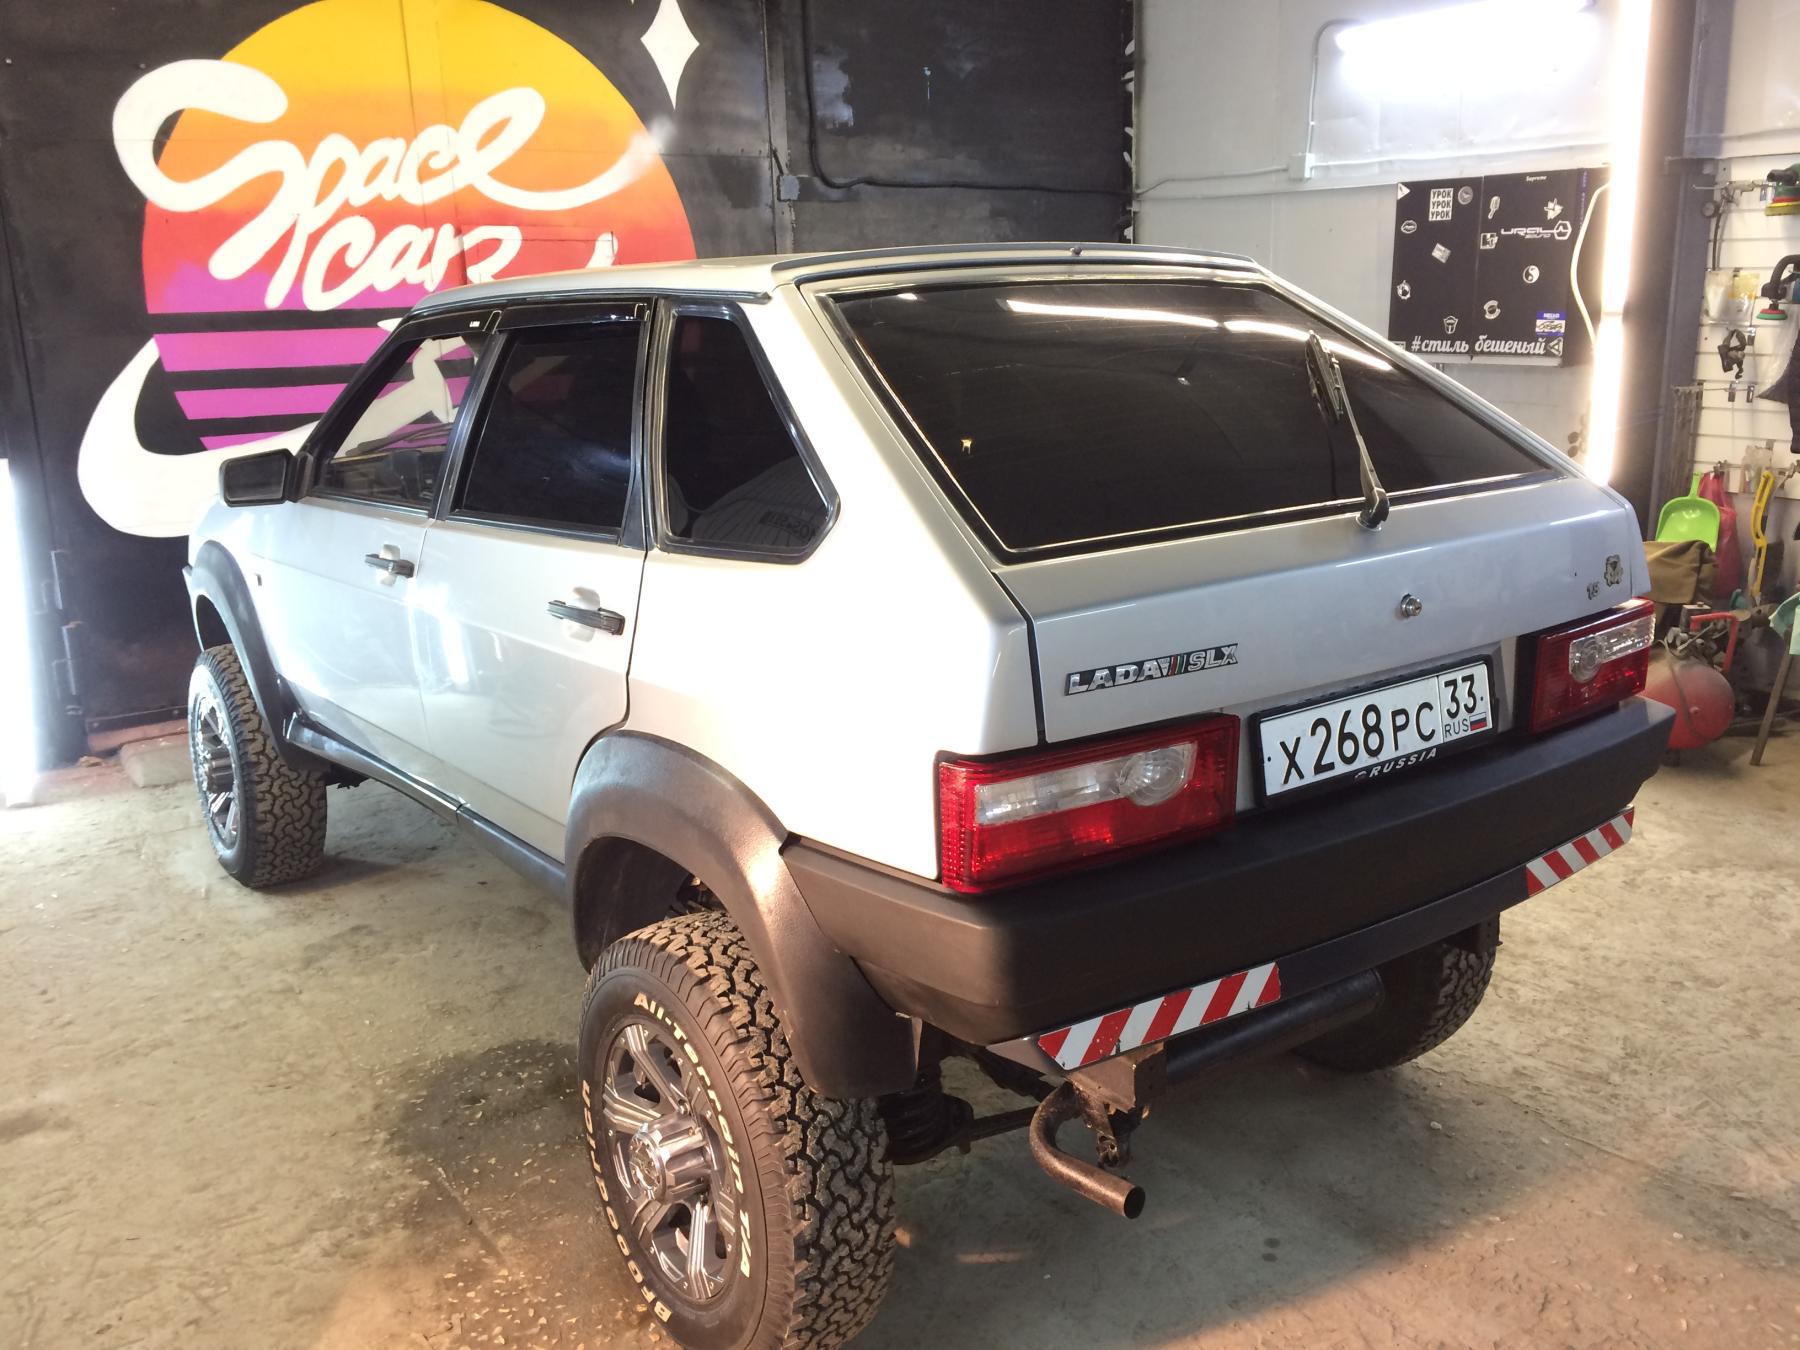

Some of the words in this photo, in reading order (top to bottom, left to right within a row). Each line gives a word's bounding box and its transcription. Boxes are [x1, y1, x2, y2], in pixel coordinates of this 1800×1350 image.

[112, 58, 672, 309] Space
[1432, 190, 1452, 199] УРОК
[1430, 210, 1451, 220] УРОК
[1431, 200, 1451, 209] УРОК
[1411, 336, 1470, 353] #стиль
[1474, 335, 1546, 355] бешеный
[1068, 658, 1163, 695] LADA
[1188, 645, 1239, 672] SLX
[1443, 674, 1478, 719] 33
[1444, 721, 1470, 740] RUS
[1369, 747, 1438, 778] RUSSIA
[633, 992, 745, 1196] All-Terrain
